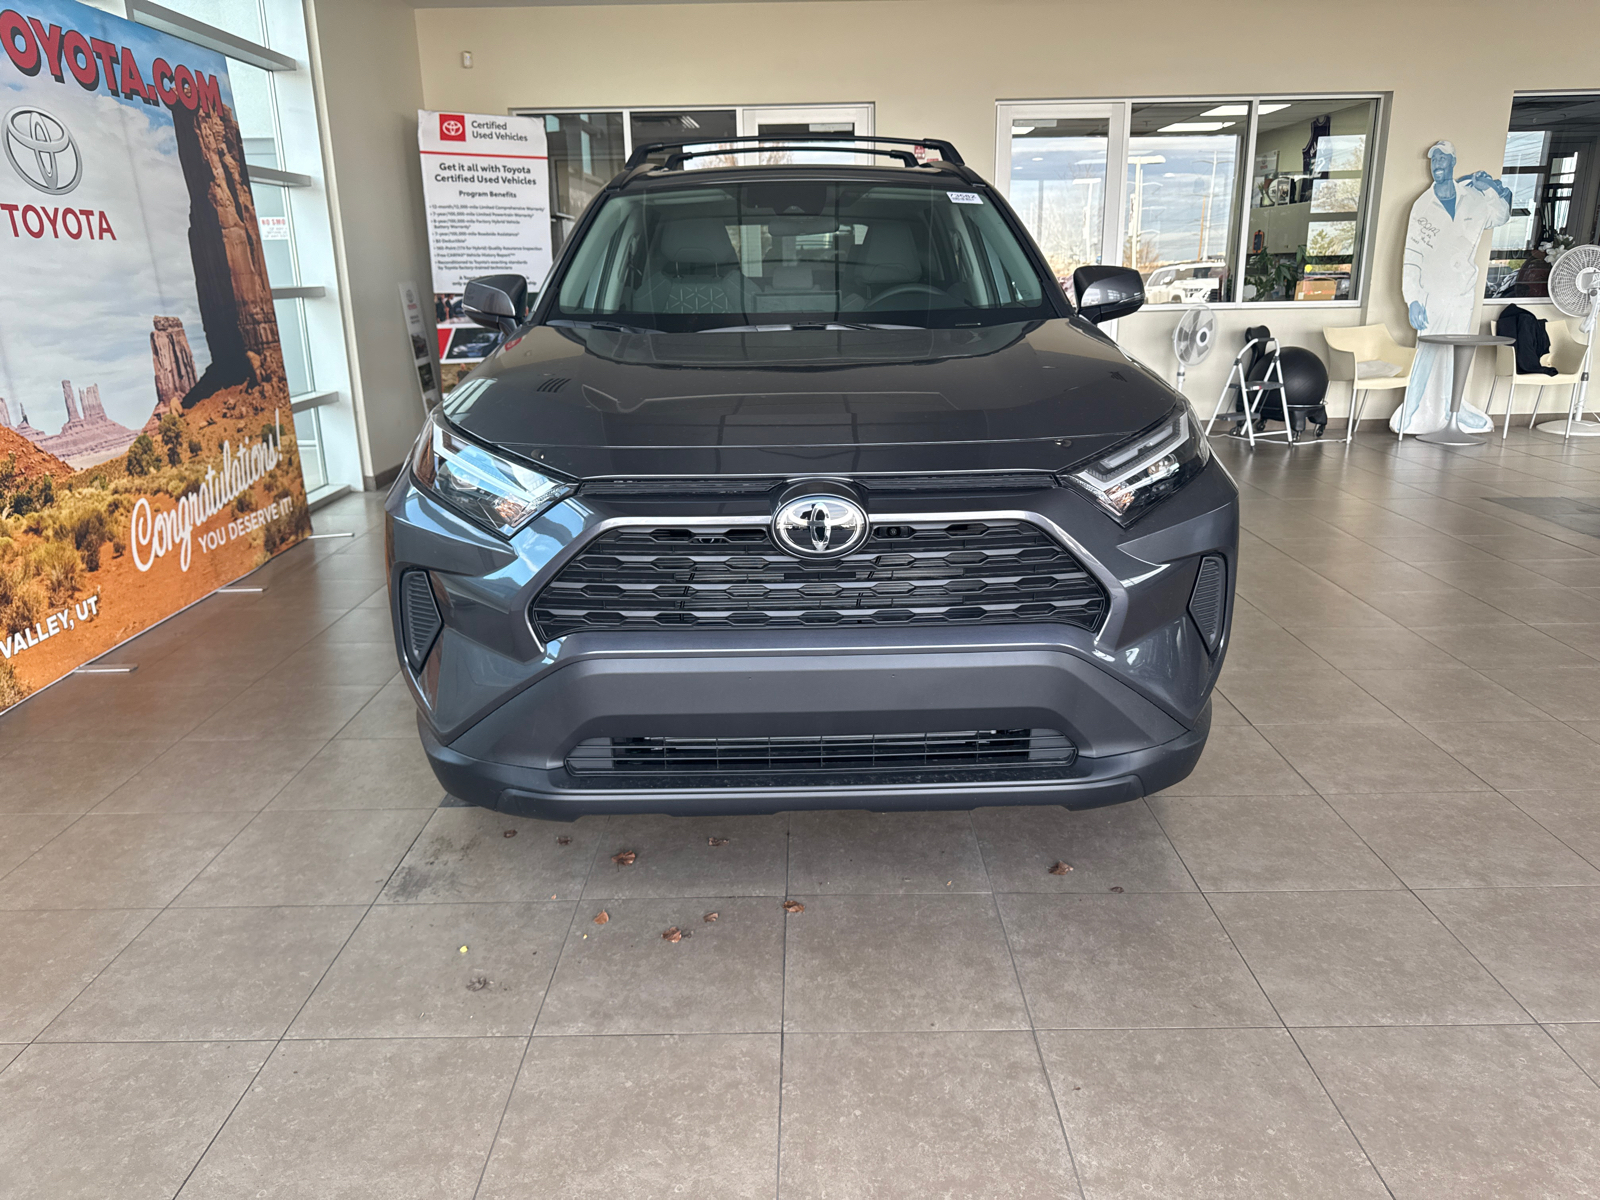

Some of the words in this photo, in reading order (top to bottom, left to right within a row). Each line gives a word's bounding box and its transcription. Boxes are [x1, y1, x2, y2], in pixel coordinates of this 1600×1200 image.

[0, 9, 224, 118] OYOTA.COM
[471, 120, 508, 130] Certified
[472, 131, 493, 139] Used
[495, 132, 528, 141] Vehicles
[434, 174, 475, 183] Certified
[477, 175, 499, 184] Used
[501, 176, 536, 185] Vehicles
[439, 162, 456, 172] Get
[458, 163, 465, 172] it
[467, 164, 478, 172] all
[480, 164, 500, 173] with
[502, 165, 531, 175] Toyota
[459, 190, 488, 199] Program
[0, 203, 117, 240] TOYOTA
[131, 408, 283, 572] Congratulations!
[198, 527, 226, 553] YOU
[228, 502, 279, 540] DESERVE
[280, 496, 294, 516] IT!
[0, 608, 75, 659] VALLEY,
[75, 595, 98, 621] UT
